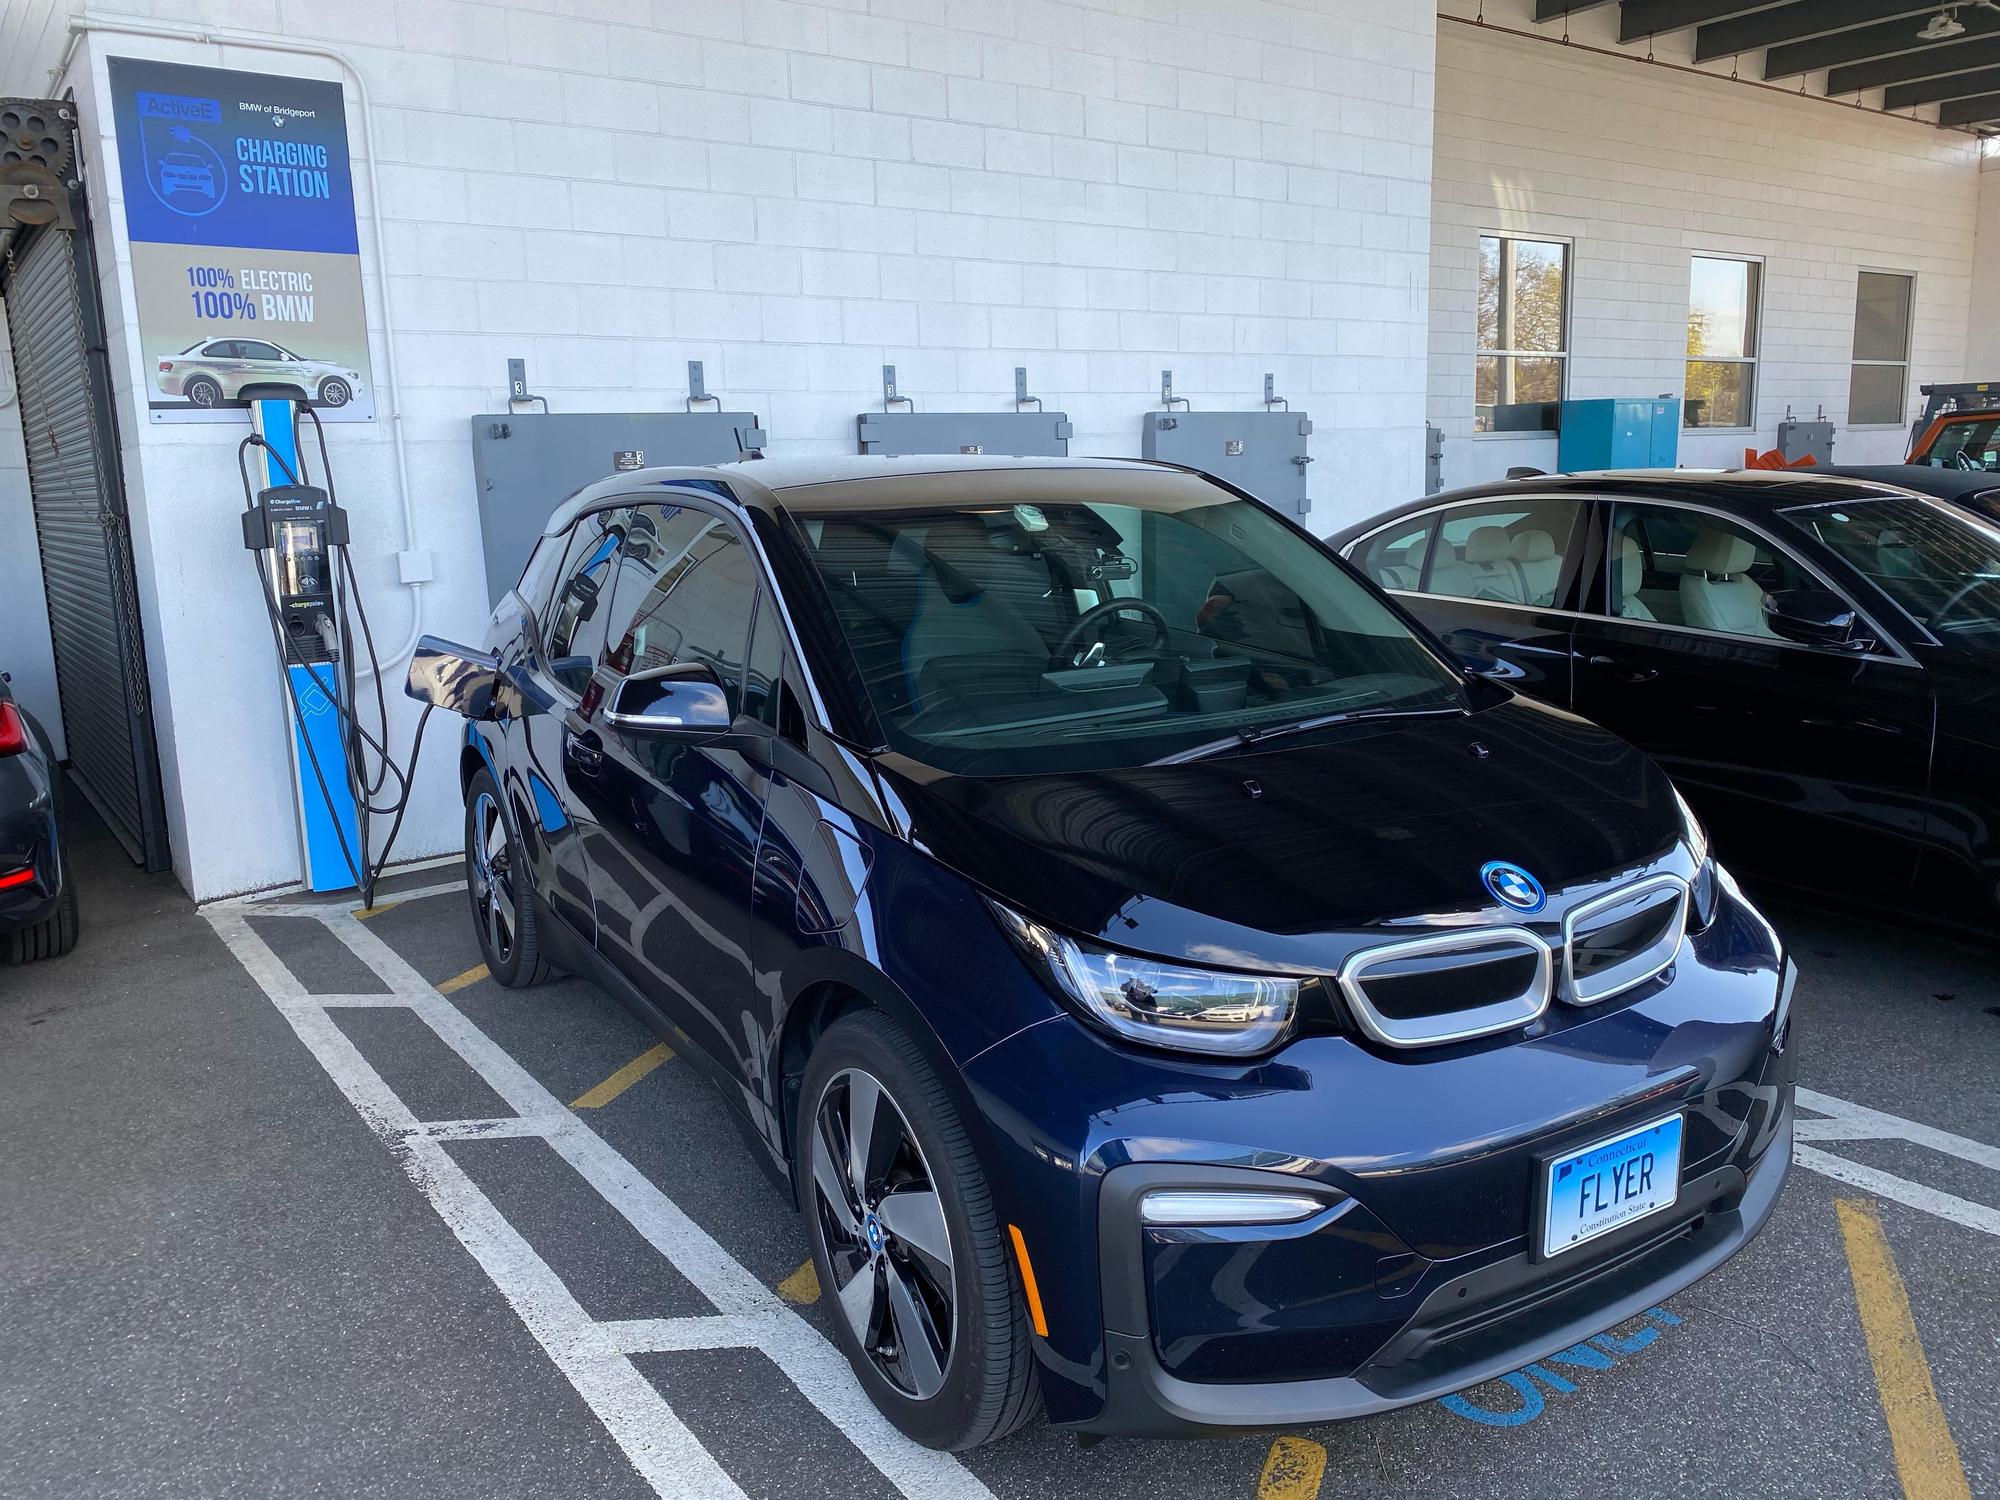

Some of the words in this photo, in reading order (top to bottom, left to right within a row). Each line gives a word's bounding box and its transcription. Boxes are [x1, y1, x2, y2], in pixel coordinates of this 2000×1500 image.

[147, 98, 213, 120] ActiveE
[239, 102, 262, 112] BMW
[263, 105, 272, 113] of
[273, 106, 316, 118] Bridgeport
[235, 137, 328, 169] CHARGING
[239, 165, 330, 200] STATION
[186, 266, 234, 289] 100%
[240, 269, 313, 293] ELECTRIC
[191, 291, 257, 321] 100%
[262, 294, 315, 322] BMW
[516, 382, 522, 394] 3
[1588, 1138, 1647, 1168] Connecticut
[1579, 1152, 1654, 1218] FLYER
[1580, 1210, 1627, 1234] Constitution
[1628, 1202, 1647, 1215] State
